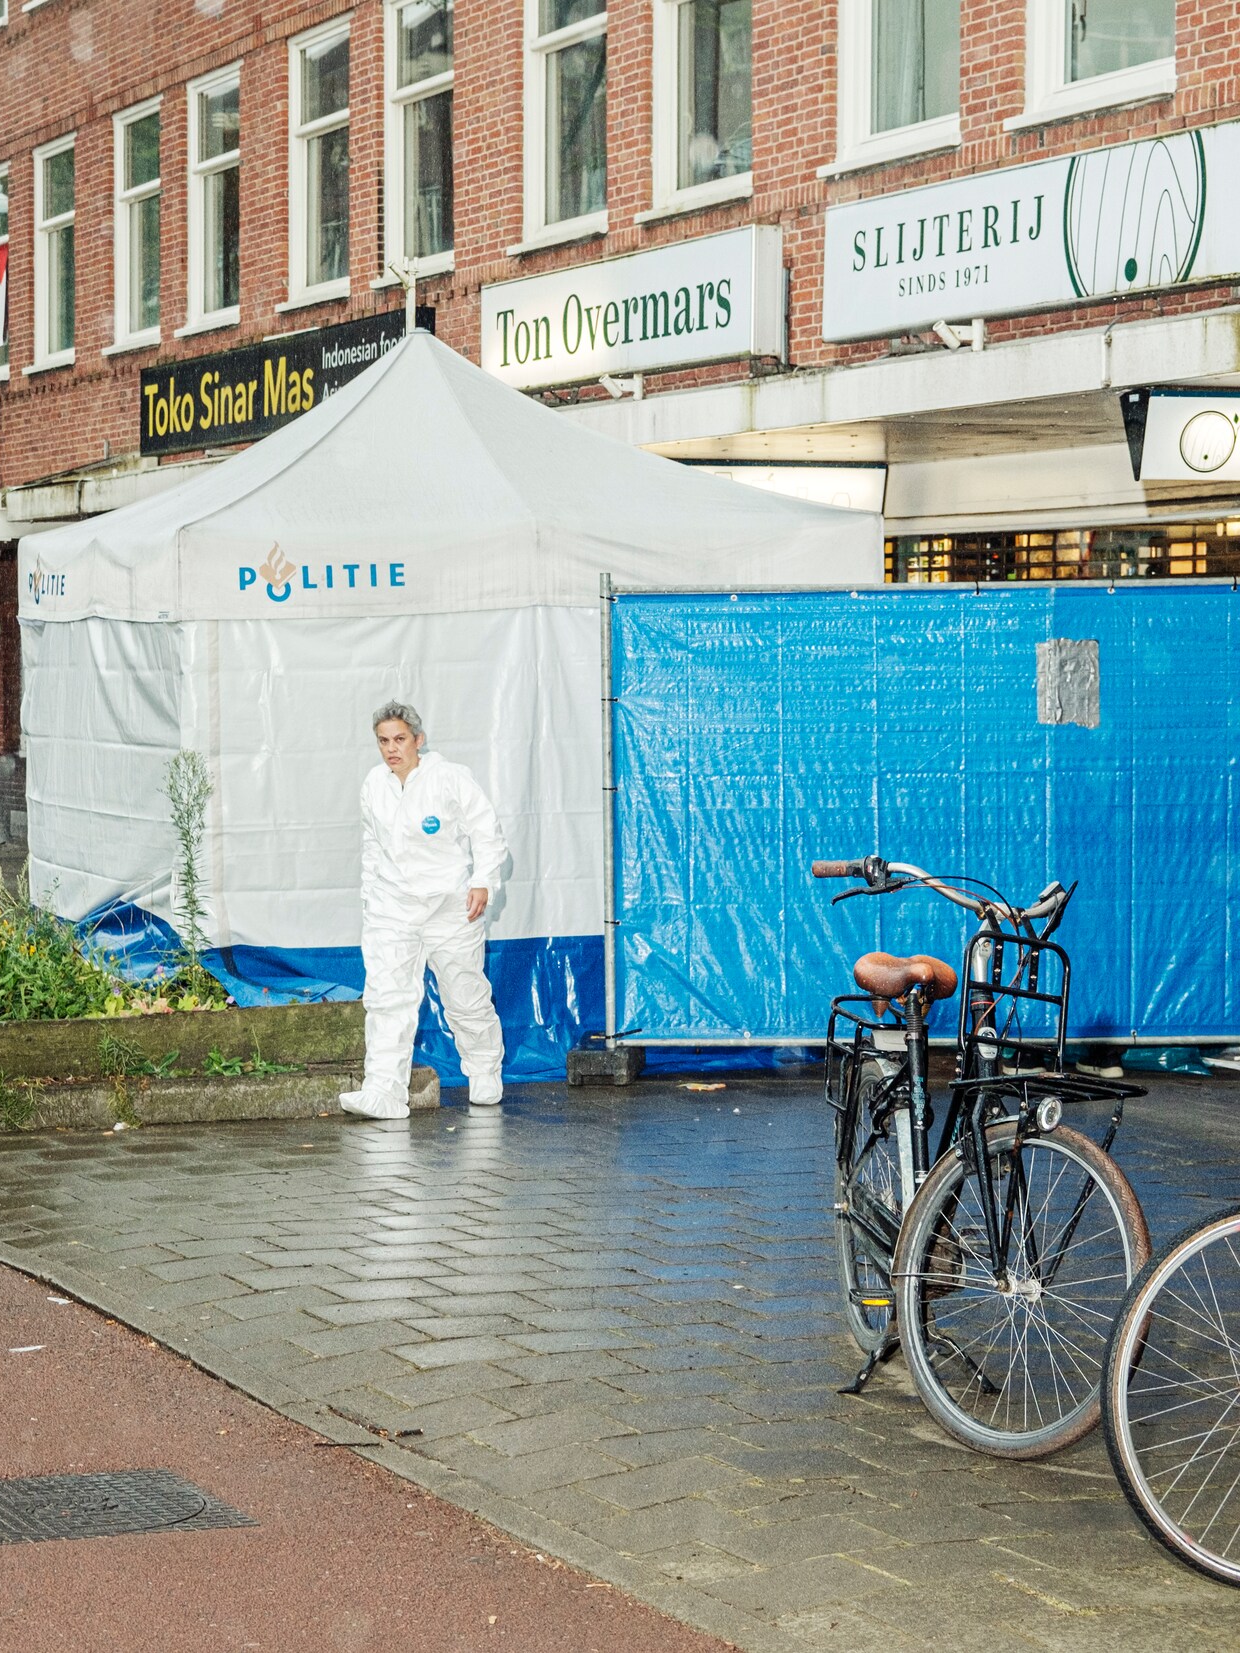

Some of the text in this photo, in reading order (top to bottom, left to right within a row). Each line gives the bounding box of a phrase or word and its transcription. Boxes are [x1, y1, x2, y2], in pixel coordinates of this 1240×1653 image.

[852, 195, 1045, 272] SLIJTERIJ
[898, 264, 990, 298] SINDS 1971
[496, 278, 732, 367] Ton Overmars
[321, 338, 377, 369] Indonesian
[144, 356, 314, 437] Toko Sinar Mas
[238, 562, 406, 603] POLITIE
